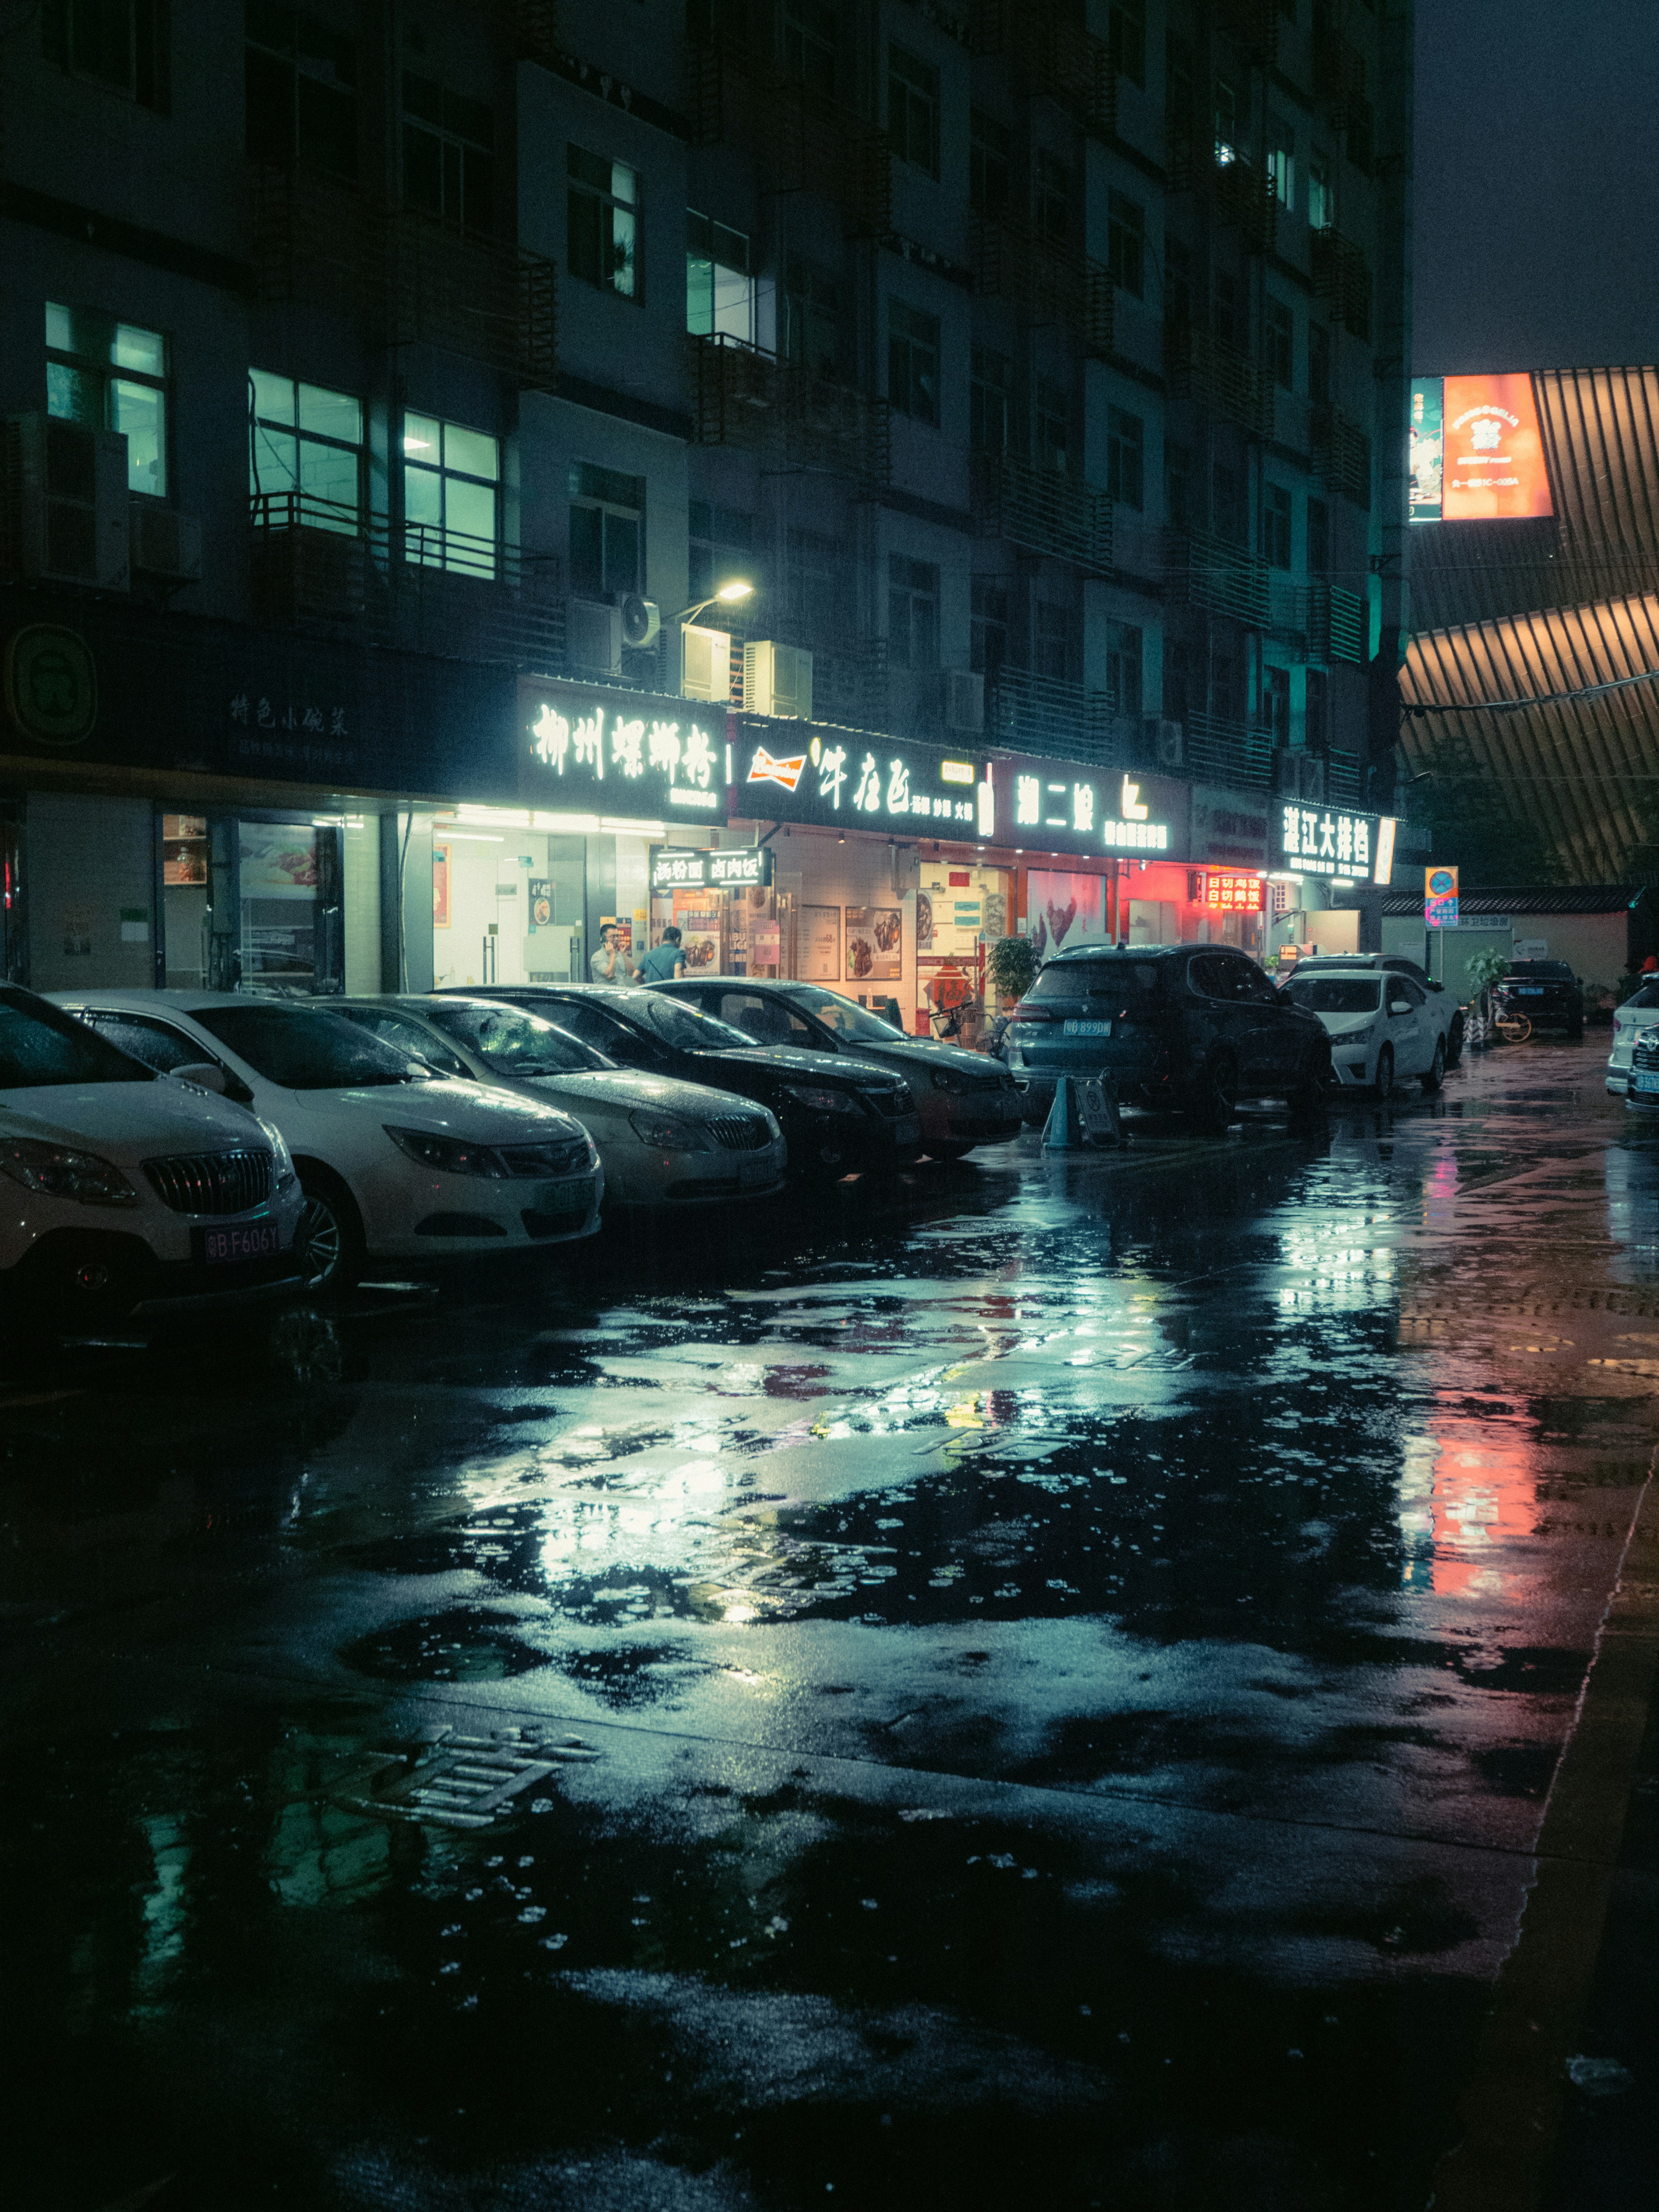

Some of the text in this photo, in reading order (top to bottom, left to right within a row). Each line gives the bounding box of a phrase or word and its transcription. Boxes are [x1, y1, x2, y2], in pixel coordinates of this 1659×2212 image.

[230, 694, 349, 737] 特色小碗菜
[533, 704, 717, 788] 柳州螺蛳粉
[1283, 806, 1369, 864] 湛江大排档
[656, 858, 759, 880] 汤粉面 卤肉饭
